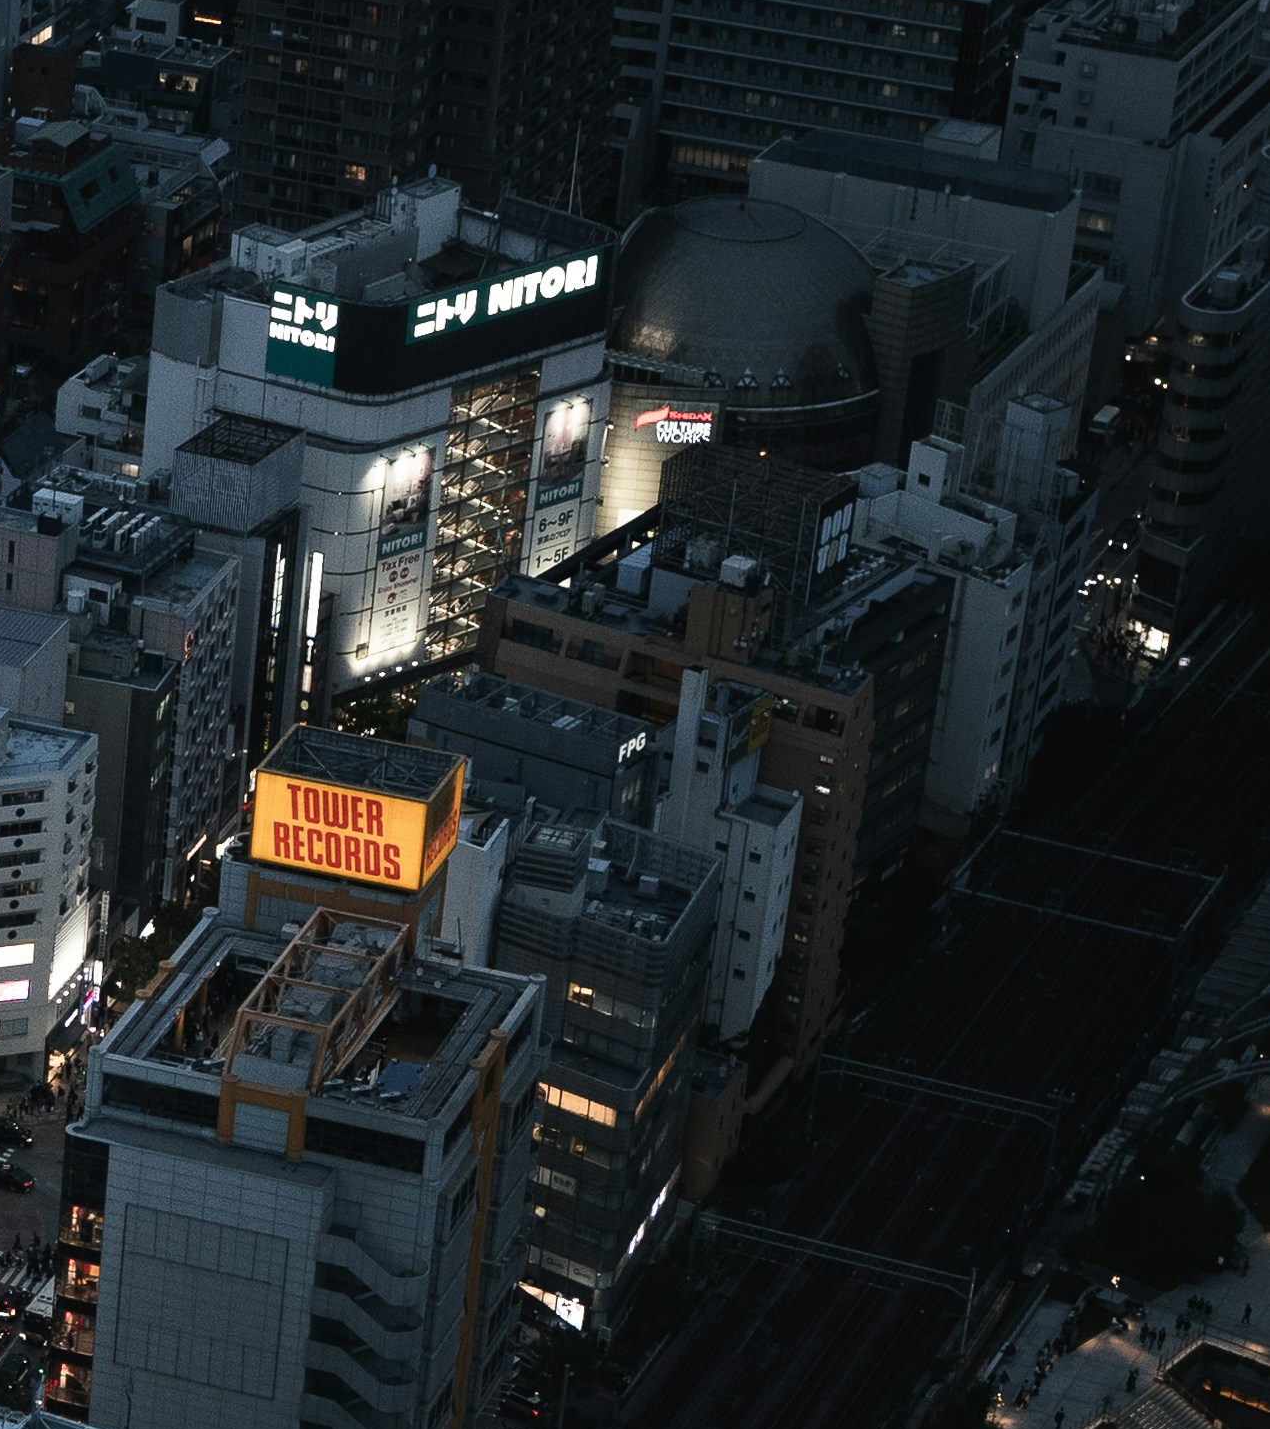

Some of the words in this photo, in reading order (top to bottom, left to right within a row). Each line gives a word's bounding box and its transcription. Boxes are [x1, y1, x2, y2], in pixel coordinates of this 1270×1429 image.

[270, 291, 338, 332] ニトリ
[413, 289, 478, 339] ニトリ
[487, 255, 598, 315] NITORI
[269, 321, 336, 353] NITORI
[656, 421, 712, 433] CULTURE
[539, 482, 580, 505] NITORI
[381, 531, 424, 556] NITORI
[381, 561, 397, 573] Tax
[398, 552, 420, 569] Free
[618, 732, 647, 764] FPG
[287, 783, 384, 837] TOWER
[273, 821, 401, 881] RECORDS
